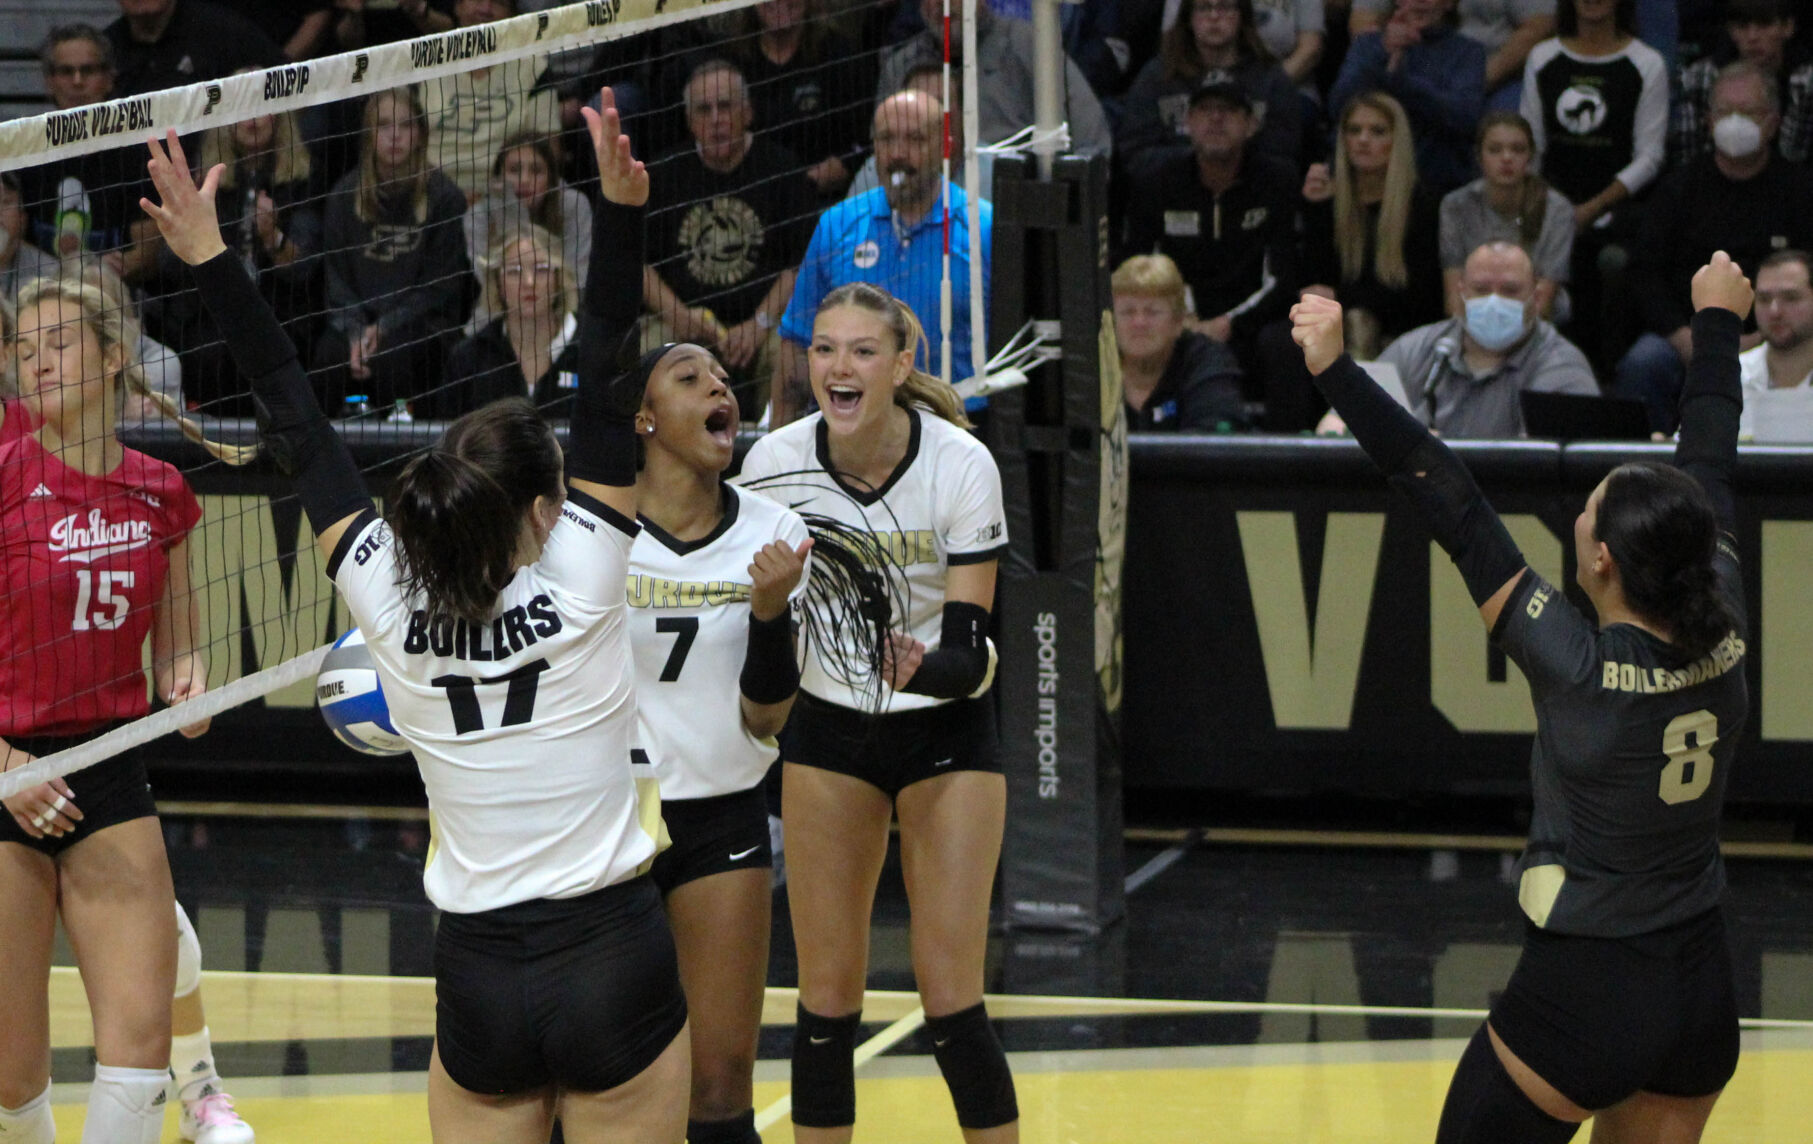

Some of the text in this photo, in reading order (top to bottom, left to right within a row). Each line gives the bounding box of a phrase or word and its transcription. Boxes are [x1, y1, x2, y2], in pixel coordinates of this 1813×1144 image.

[48, 508, 153, 558] Indiana
[72, 569, 136, 631] 15
[626, 573, 753, 609] URDUE
[404, 593, 564, 662] BOILERS
[656, 616, 699, 682] 7
[431, 657, 551, 735] 17
[1033, 612, 1061, 799] sports imports
[1658, 709, 1719, 805] 8
